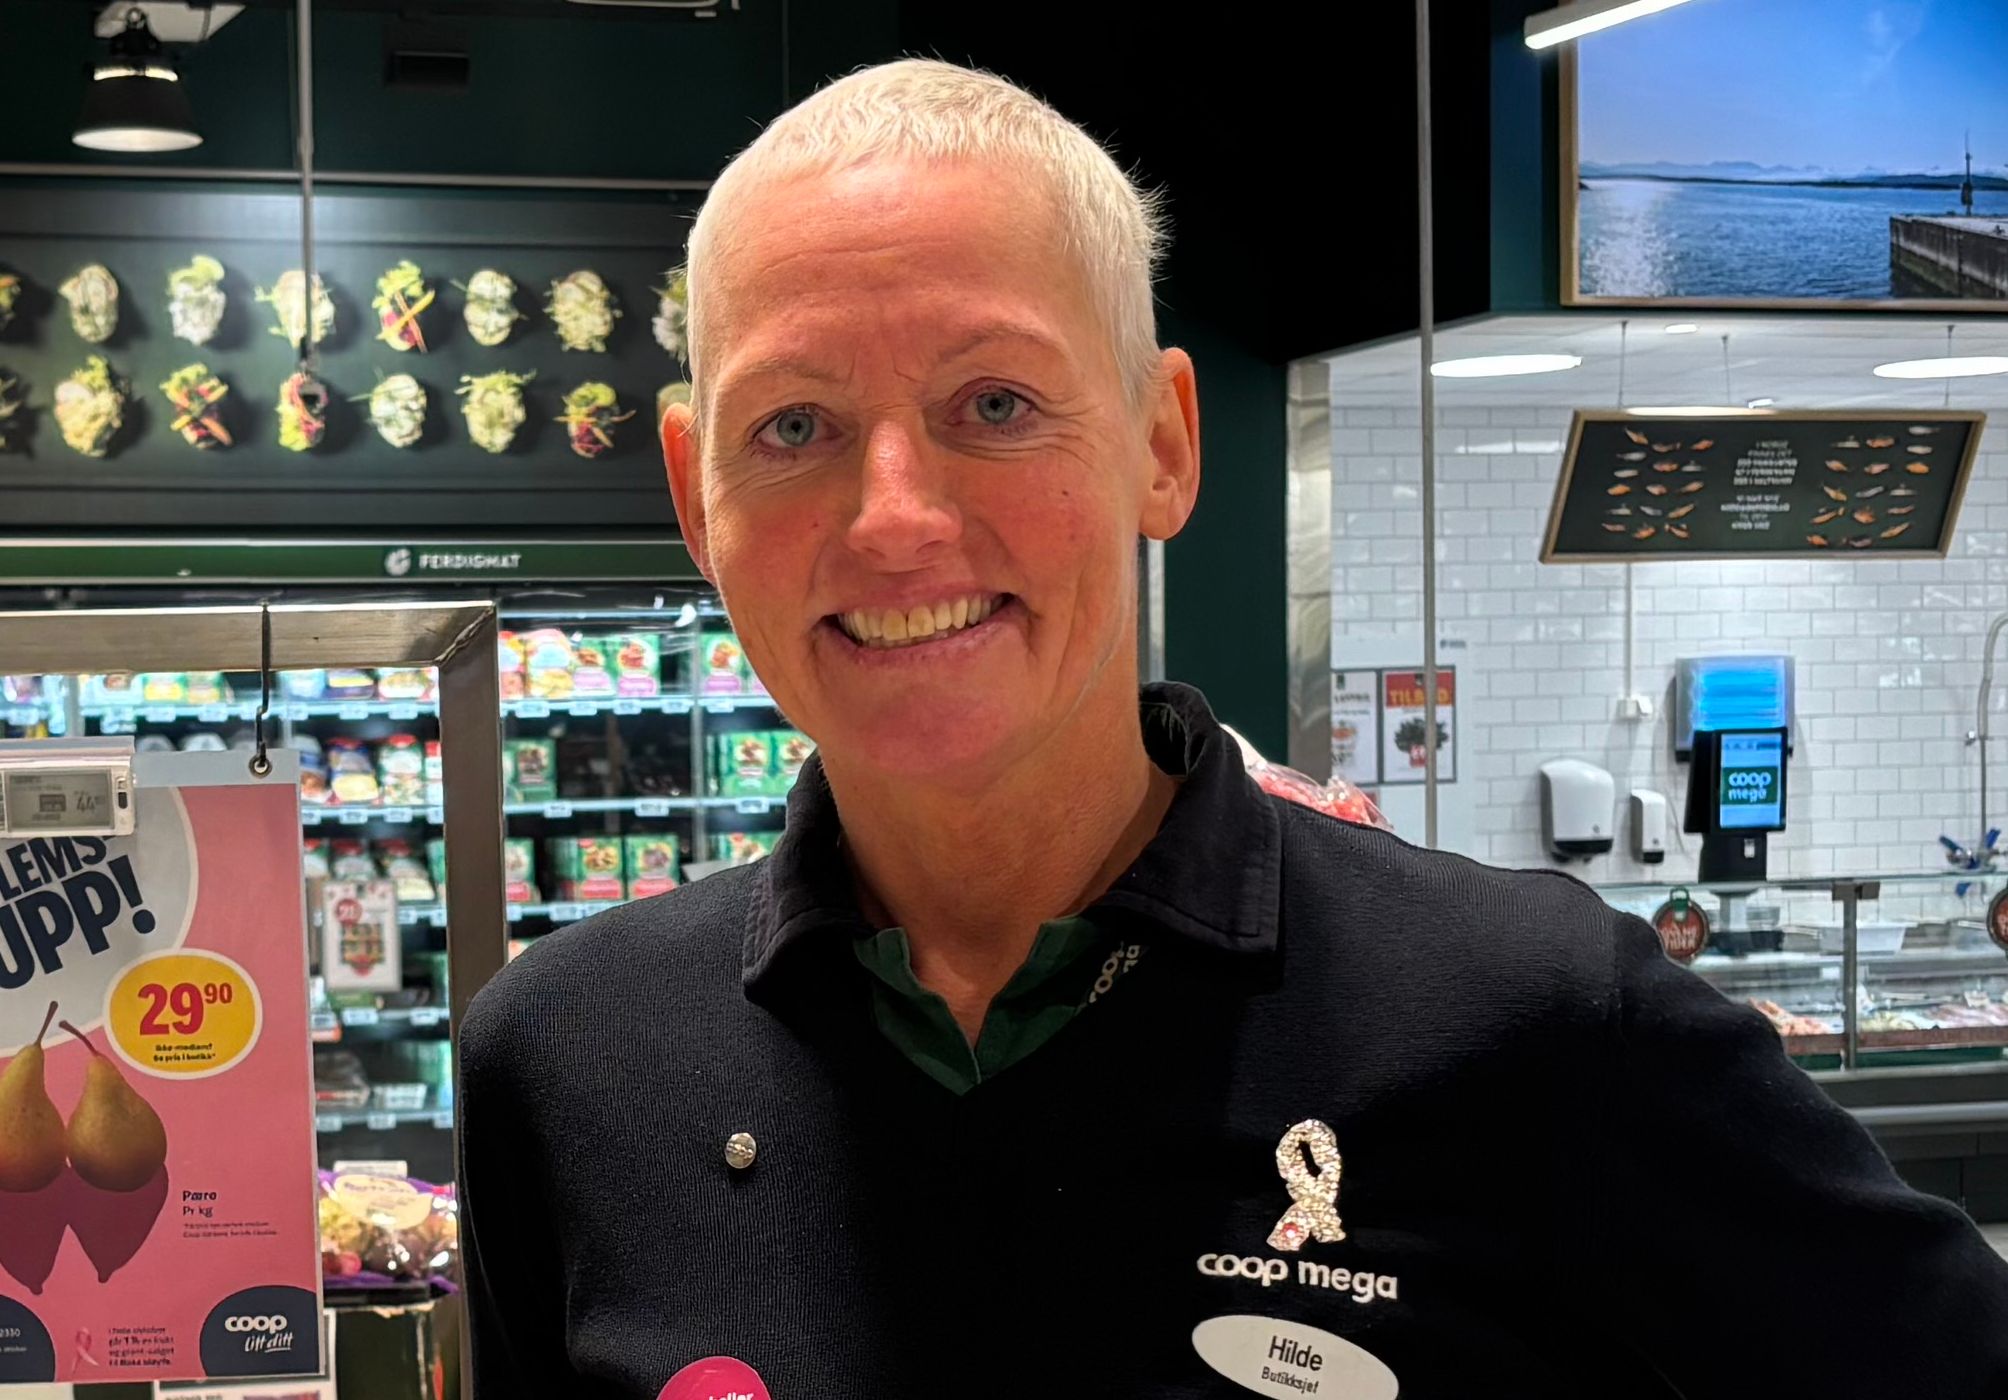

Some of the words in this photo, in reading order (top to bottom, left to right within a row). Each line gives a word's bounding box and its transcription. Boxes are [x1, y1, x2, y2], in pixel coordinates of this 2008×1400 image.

[419, 554, 521, 569] FERDIGMAT
[1391, 688, 1451, 705] TILBD
[1728, 772, 1771, 788] coop
[1196, 1253, 1289, 1287] coop
[1298, 1260, 1398, 1303] mega
[224, 1314, 288, 1334] coop
[1268, 1335, 1323, 1371] Hilde
[1261, 1366, 1320, 1395] Butikksjef
